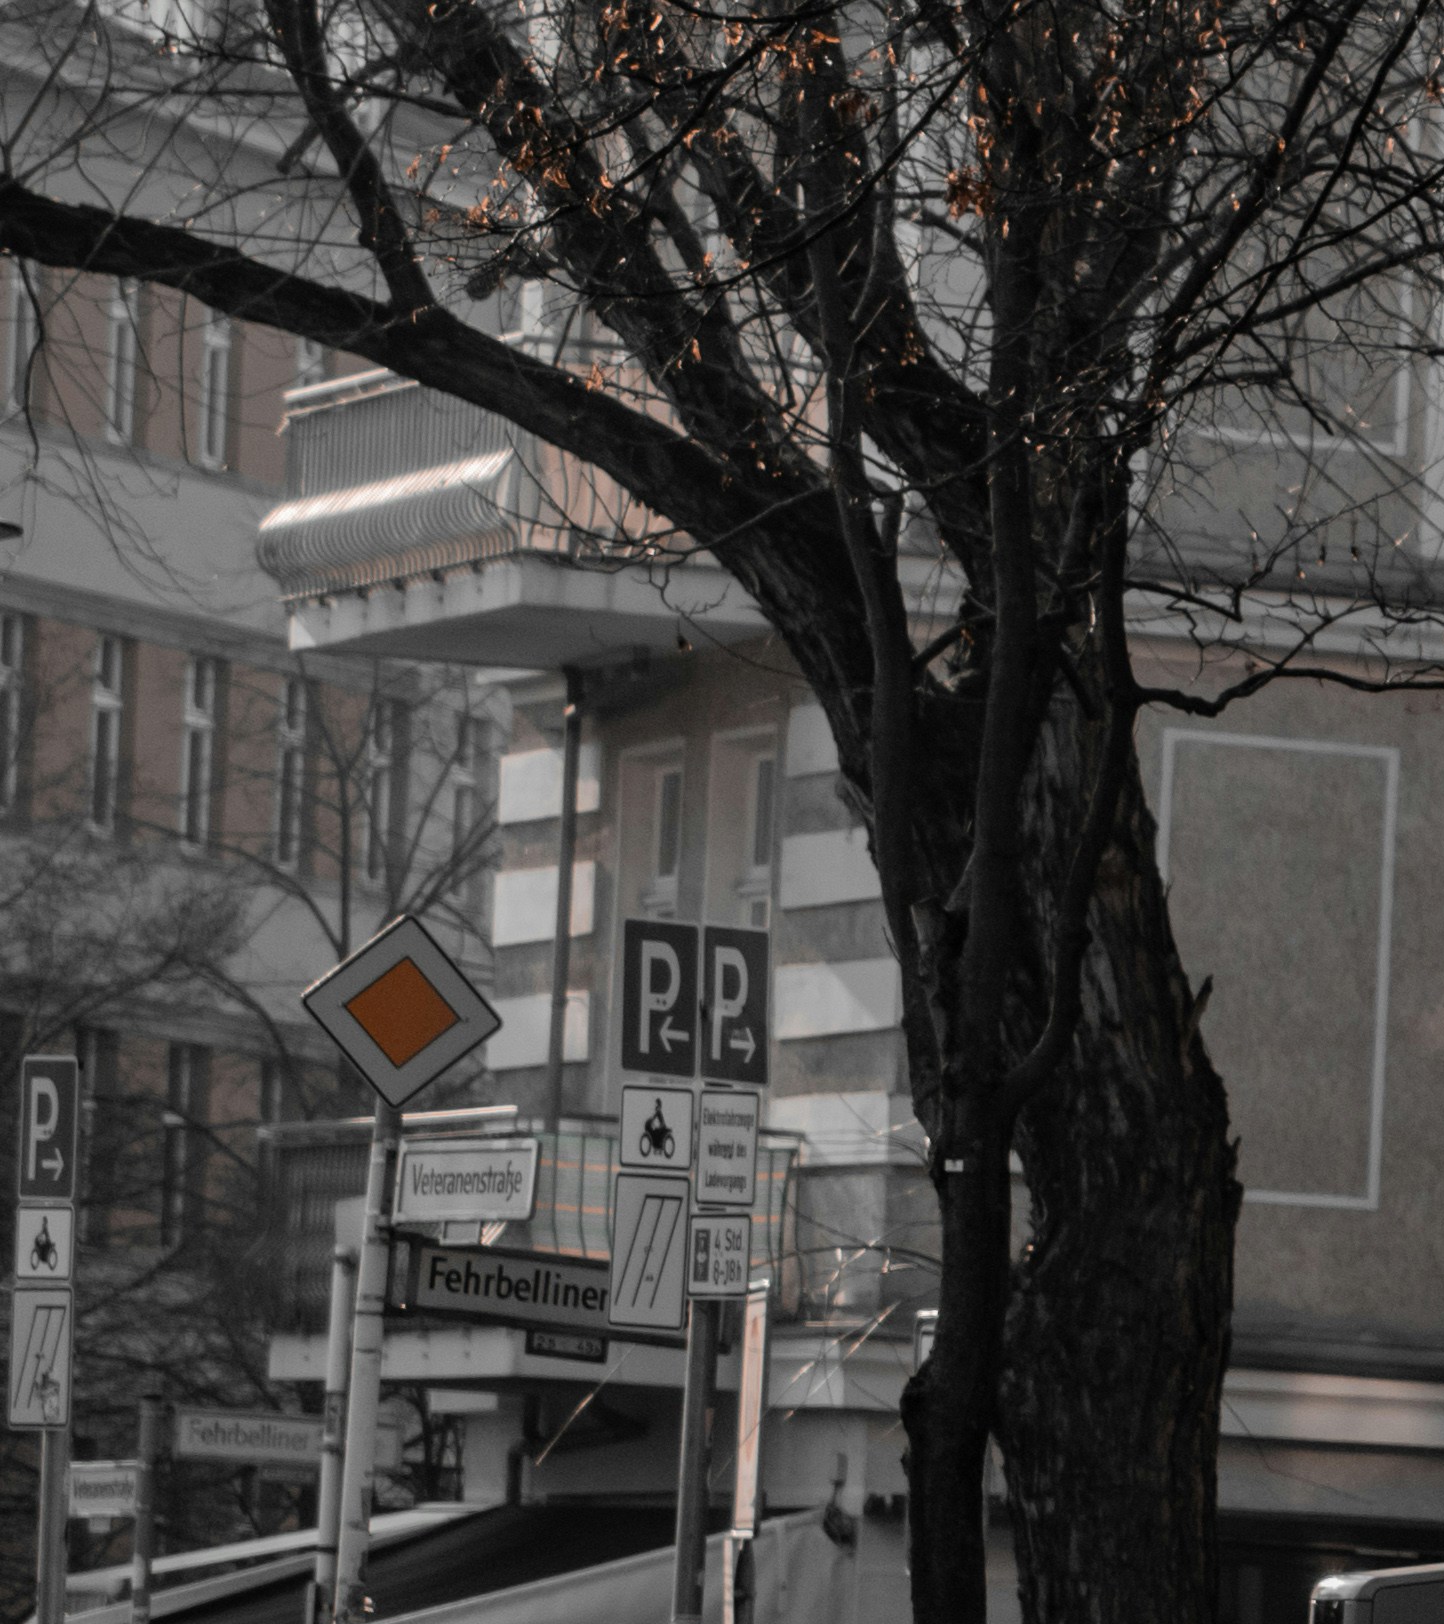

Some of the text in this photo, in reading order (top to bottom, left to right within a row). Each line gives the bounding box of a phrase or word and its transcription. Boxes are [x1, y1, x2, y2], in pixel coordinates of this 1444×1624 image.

[640, 940, 681, 1054] P
[712, 946, 748, 1060] P
[28, 1077, 59, 1181] P
[412, 1160, 523, 1201] Veteranenstraße
[429, 1255, 608, 1311] Fehrbelliner
